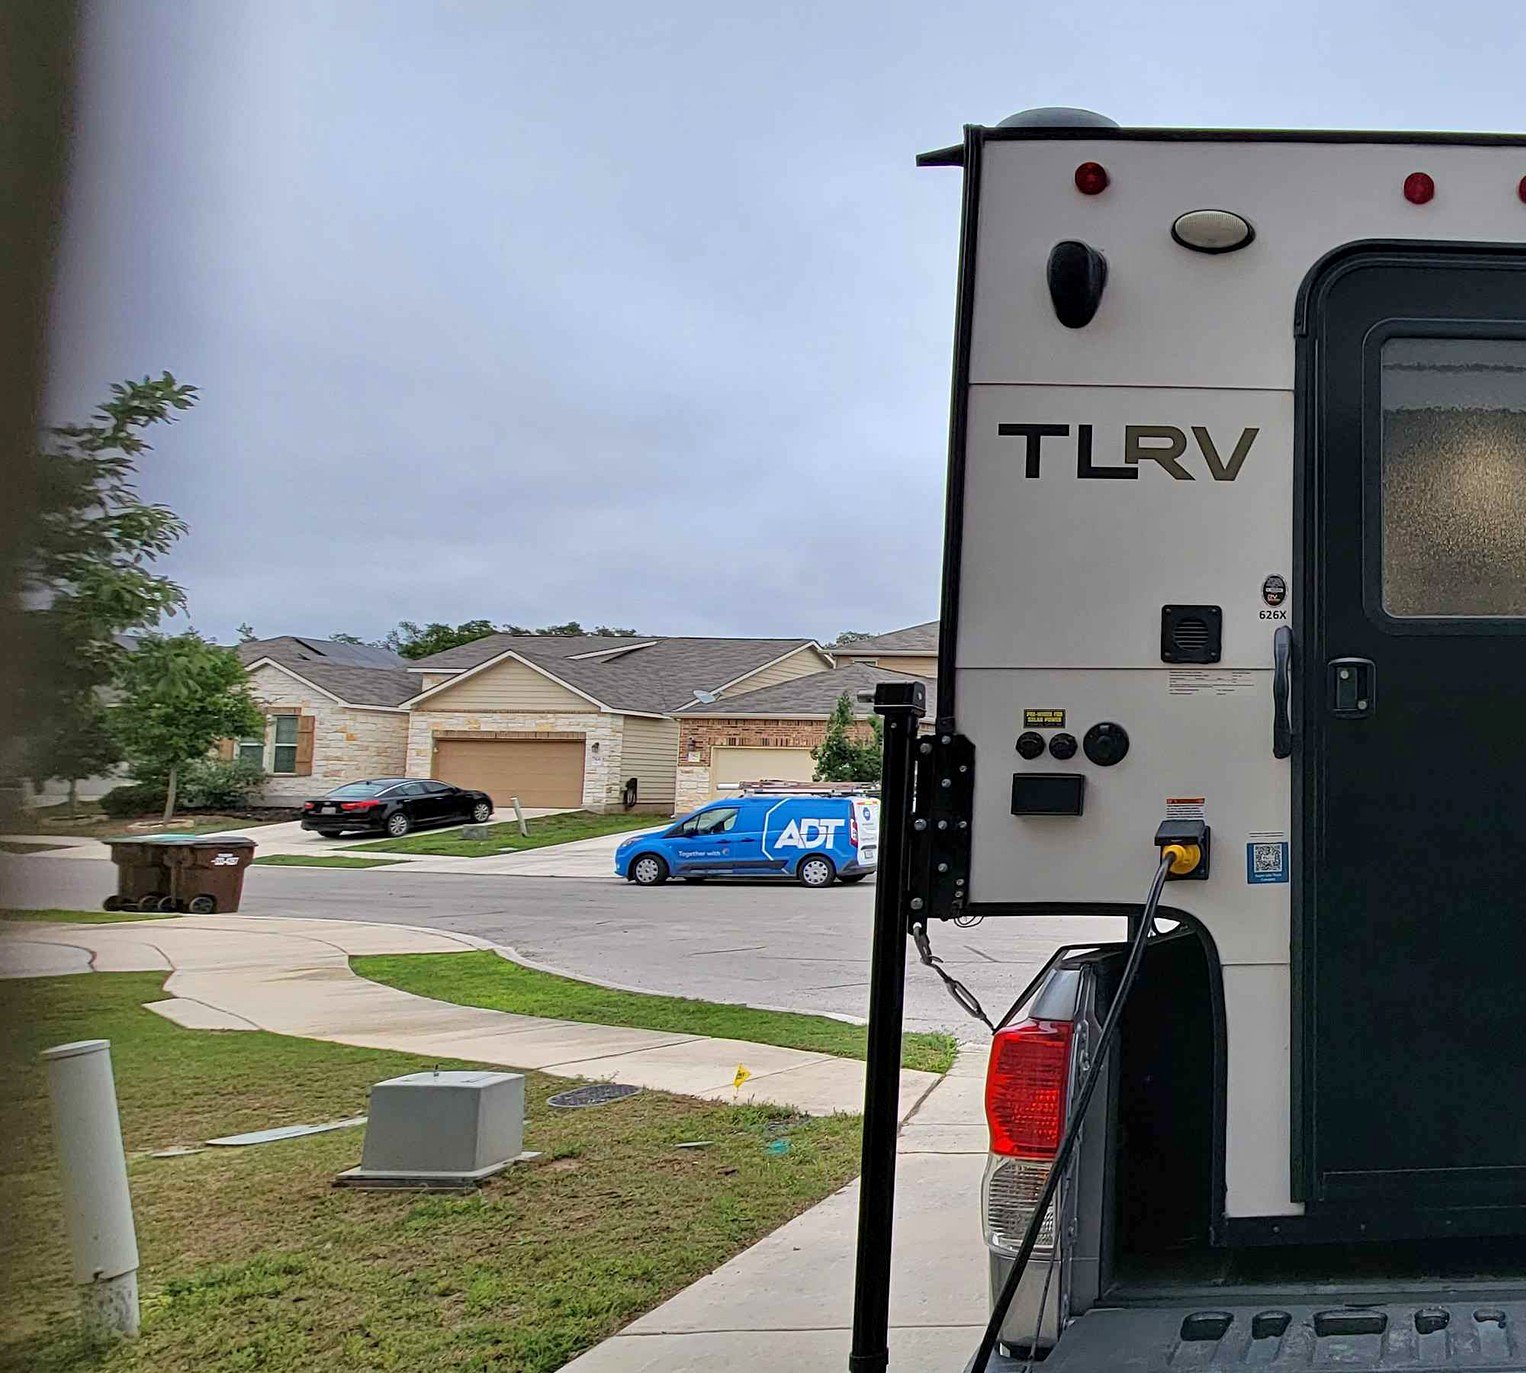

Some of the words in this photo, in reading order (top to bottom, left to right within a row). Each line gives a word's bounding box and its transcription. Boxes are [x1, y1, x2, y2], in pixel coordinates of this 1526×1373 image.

[998, 423, 1260, 482] TLRV
[1259, 610, 1287, 620] 626X
[774, 818, 846, 849] ADT
[678, 850, 706, 858] Together
